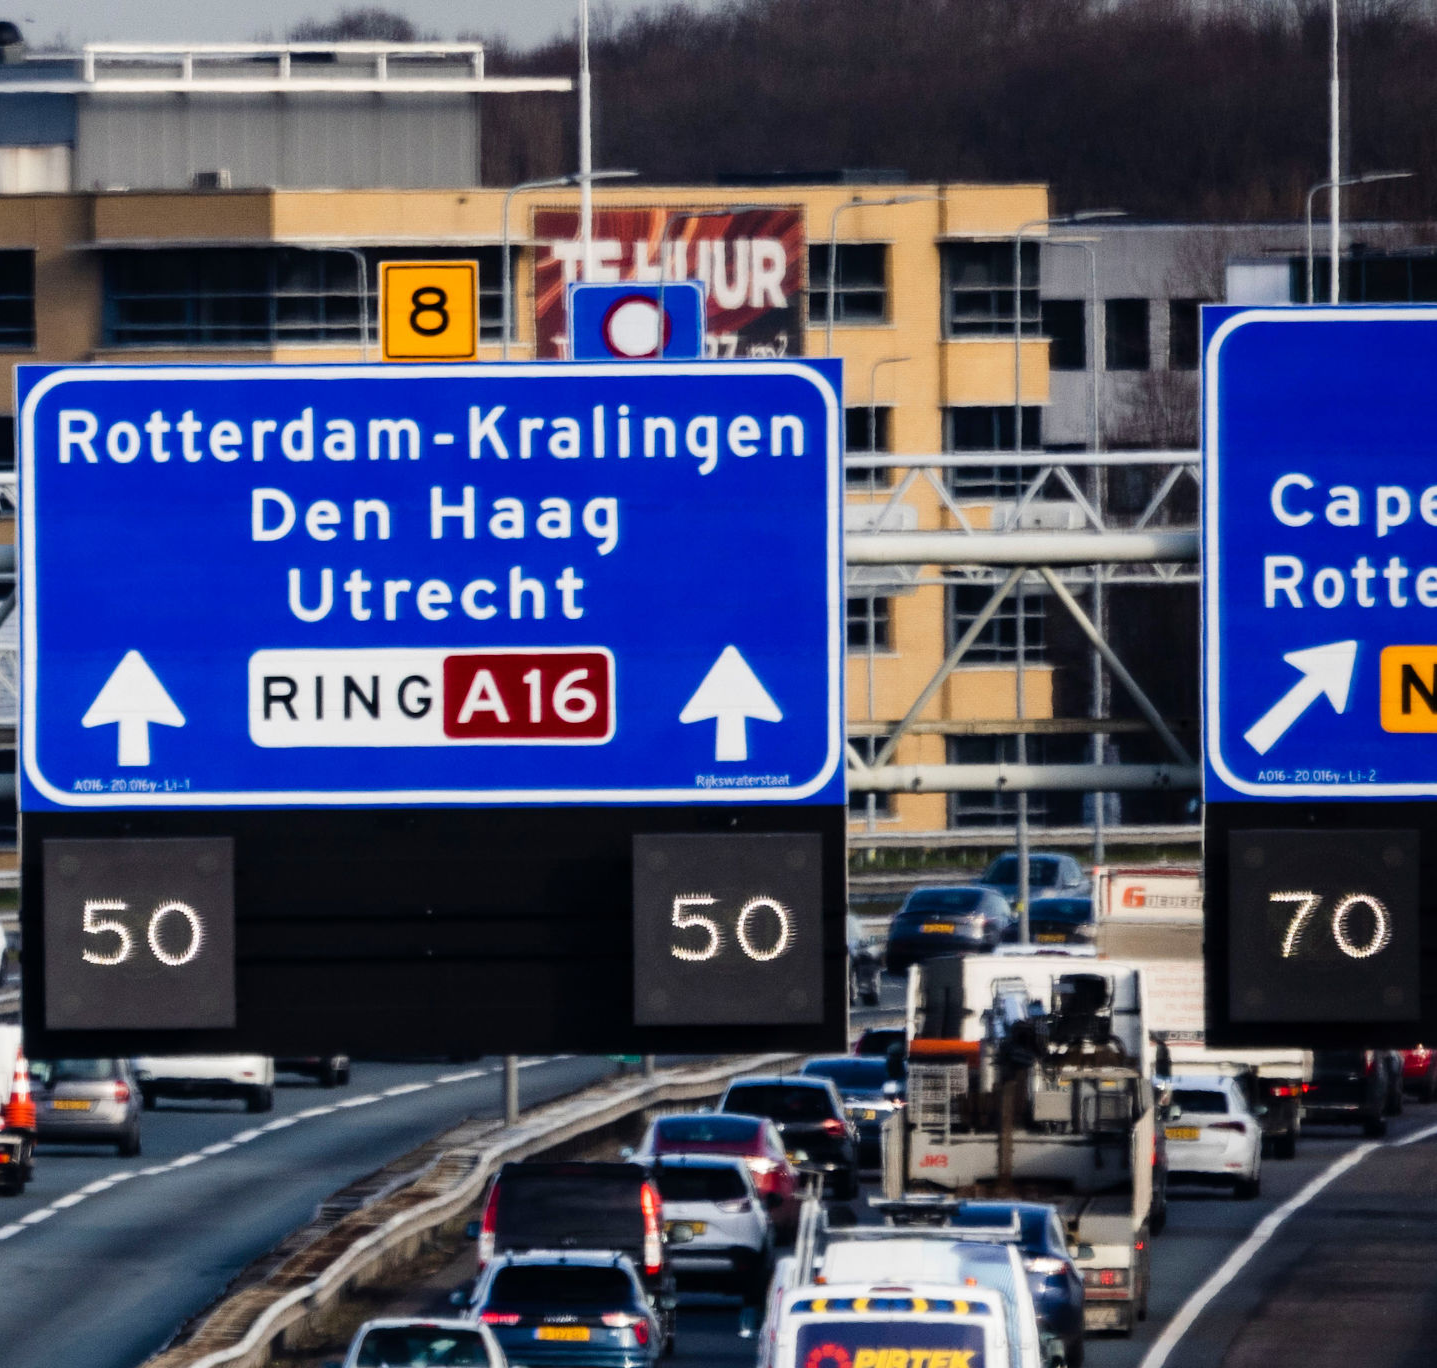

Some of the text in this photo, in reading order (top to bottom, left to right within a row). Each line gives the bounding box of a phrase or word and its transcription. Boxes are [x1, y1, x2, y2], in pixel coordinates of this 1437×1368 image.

[410, 286, 449, 337] 8
[58, 405, 806, 474] Rotterdam-Kralingen
[252, 486, 621, 555] Den Haag
[288, 567, 584, 622] Utrecht
[263, 668, 598, 724] RING A16
[696, 775, 790, 789] Rijkswaterstaat
[81, 898, 204, 968] 50
[670, 892, 796, 963] 50
[1269, 891, 1392, 959] 70
